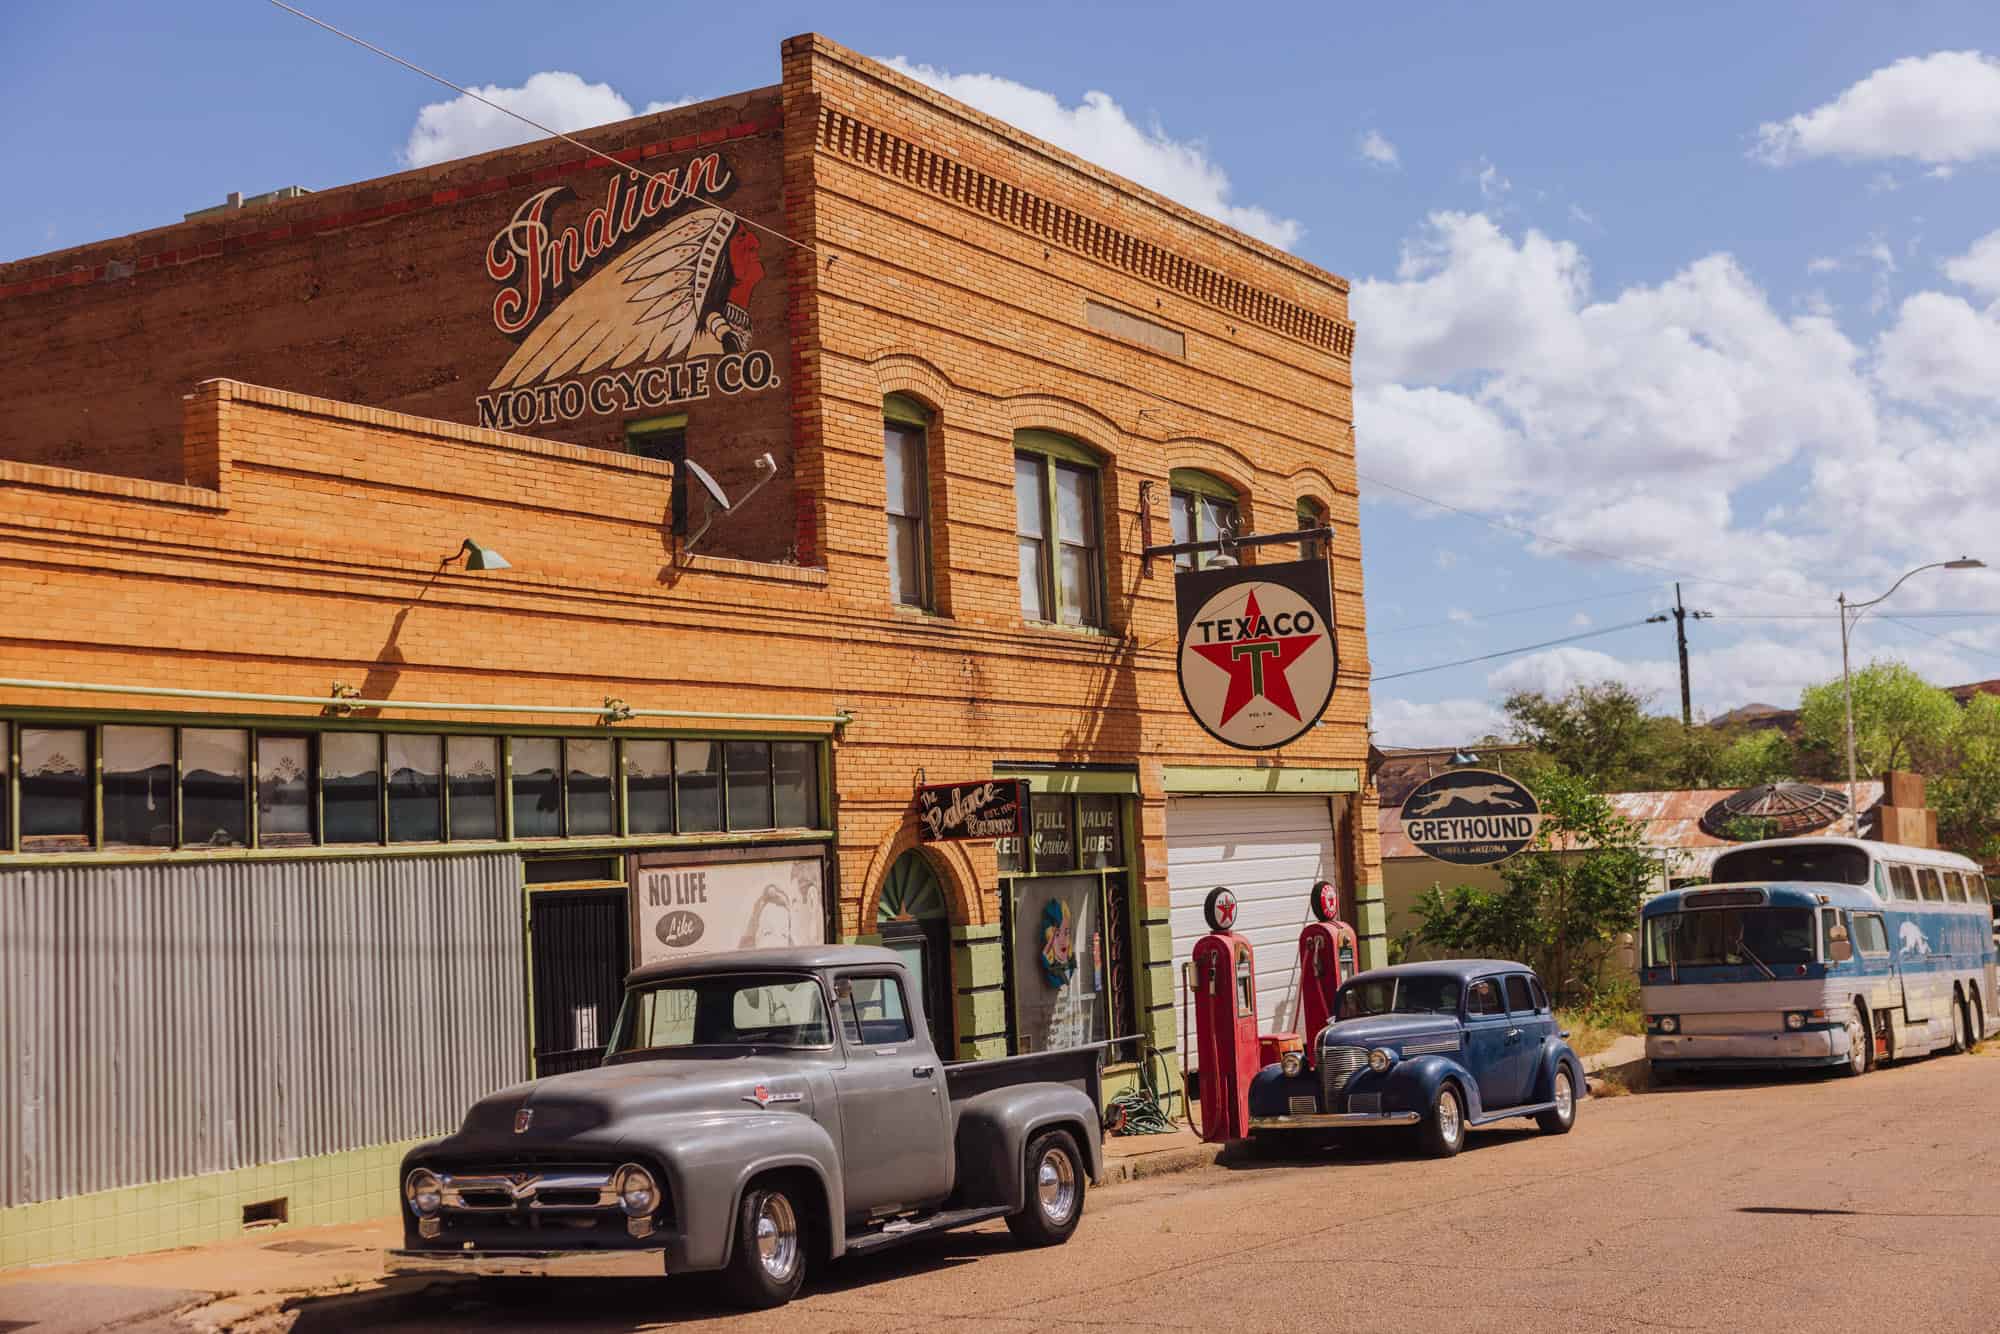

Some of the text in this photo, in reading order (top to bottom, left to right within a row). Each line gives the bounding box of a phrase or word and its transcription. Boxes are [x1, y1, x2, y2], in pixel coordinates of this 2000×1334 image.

[486, 152, 732, 334] Indian
[715, 350, 781, 394] CO.
[1197, 611, 1315, 643] TEXACO
[1035, 811, 1066, 830] FULL
[1080, 811, 1113, 828] VALVE
[1407, 816, 1533, 842] GREYHOUND
[1082, 835, 1113, 853] JOBS
[648, 871, 708, 907] NO LIFE
[665, 913, 696, 943] Like
